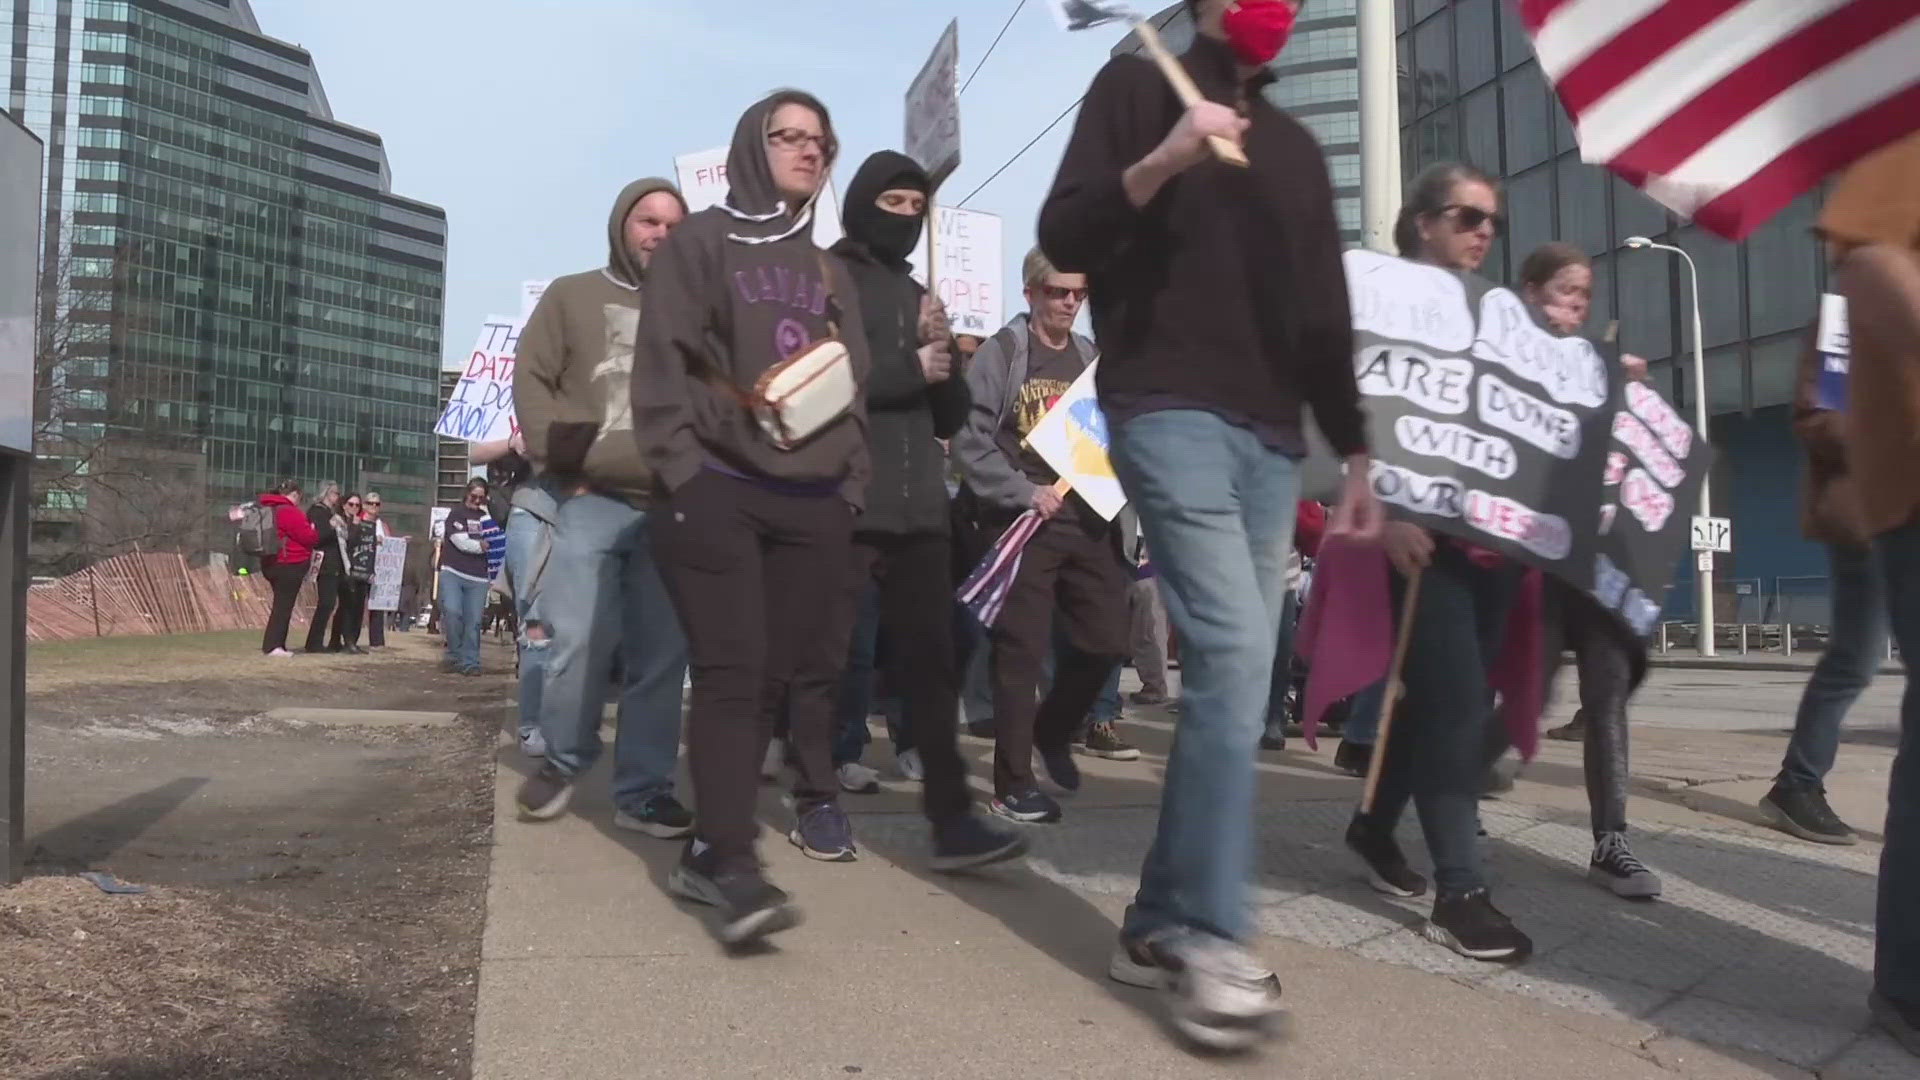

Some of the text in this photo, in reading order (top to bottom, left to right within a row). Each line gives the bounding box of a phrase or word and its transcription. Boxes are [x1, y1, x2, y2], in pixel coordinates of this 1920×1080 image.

[938, 209, 970, 238] WE
[936, 242, 973, 273] HE
[911, 273, 992, 314] OPLE
[466, 351, 516, 382] DAT
[451, 379, 515, 412] I DO
[1357, 349, 1462, 405] ARE
[1488, 383, 1571, 446] DONE
[436, 402, 500, 440] KNOW
[1400, 420, 1509, 476] WITH
